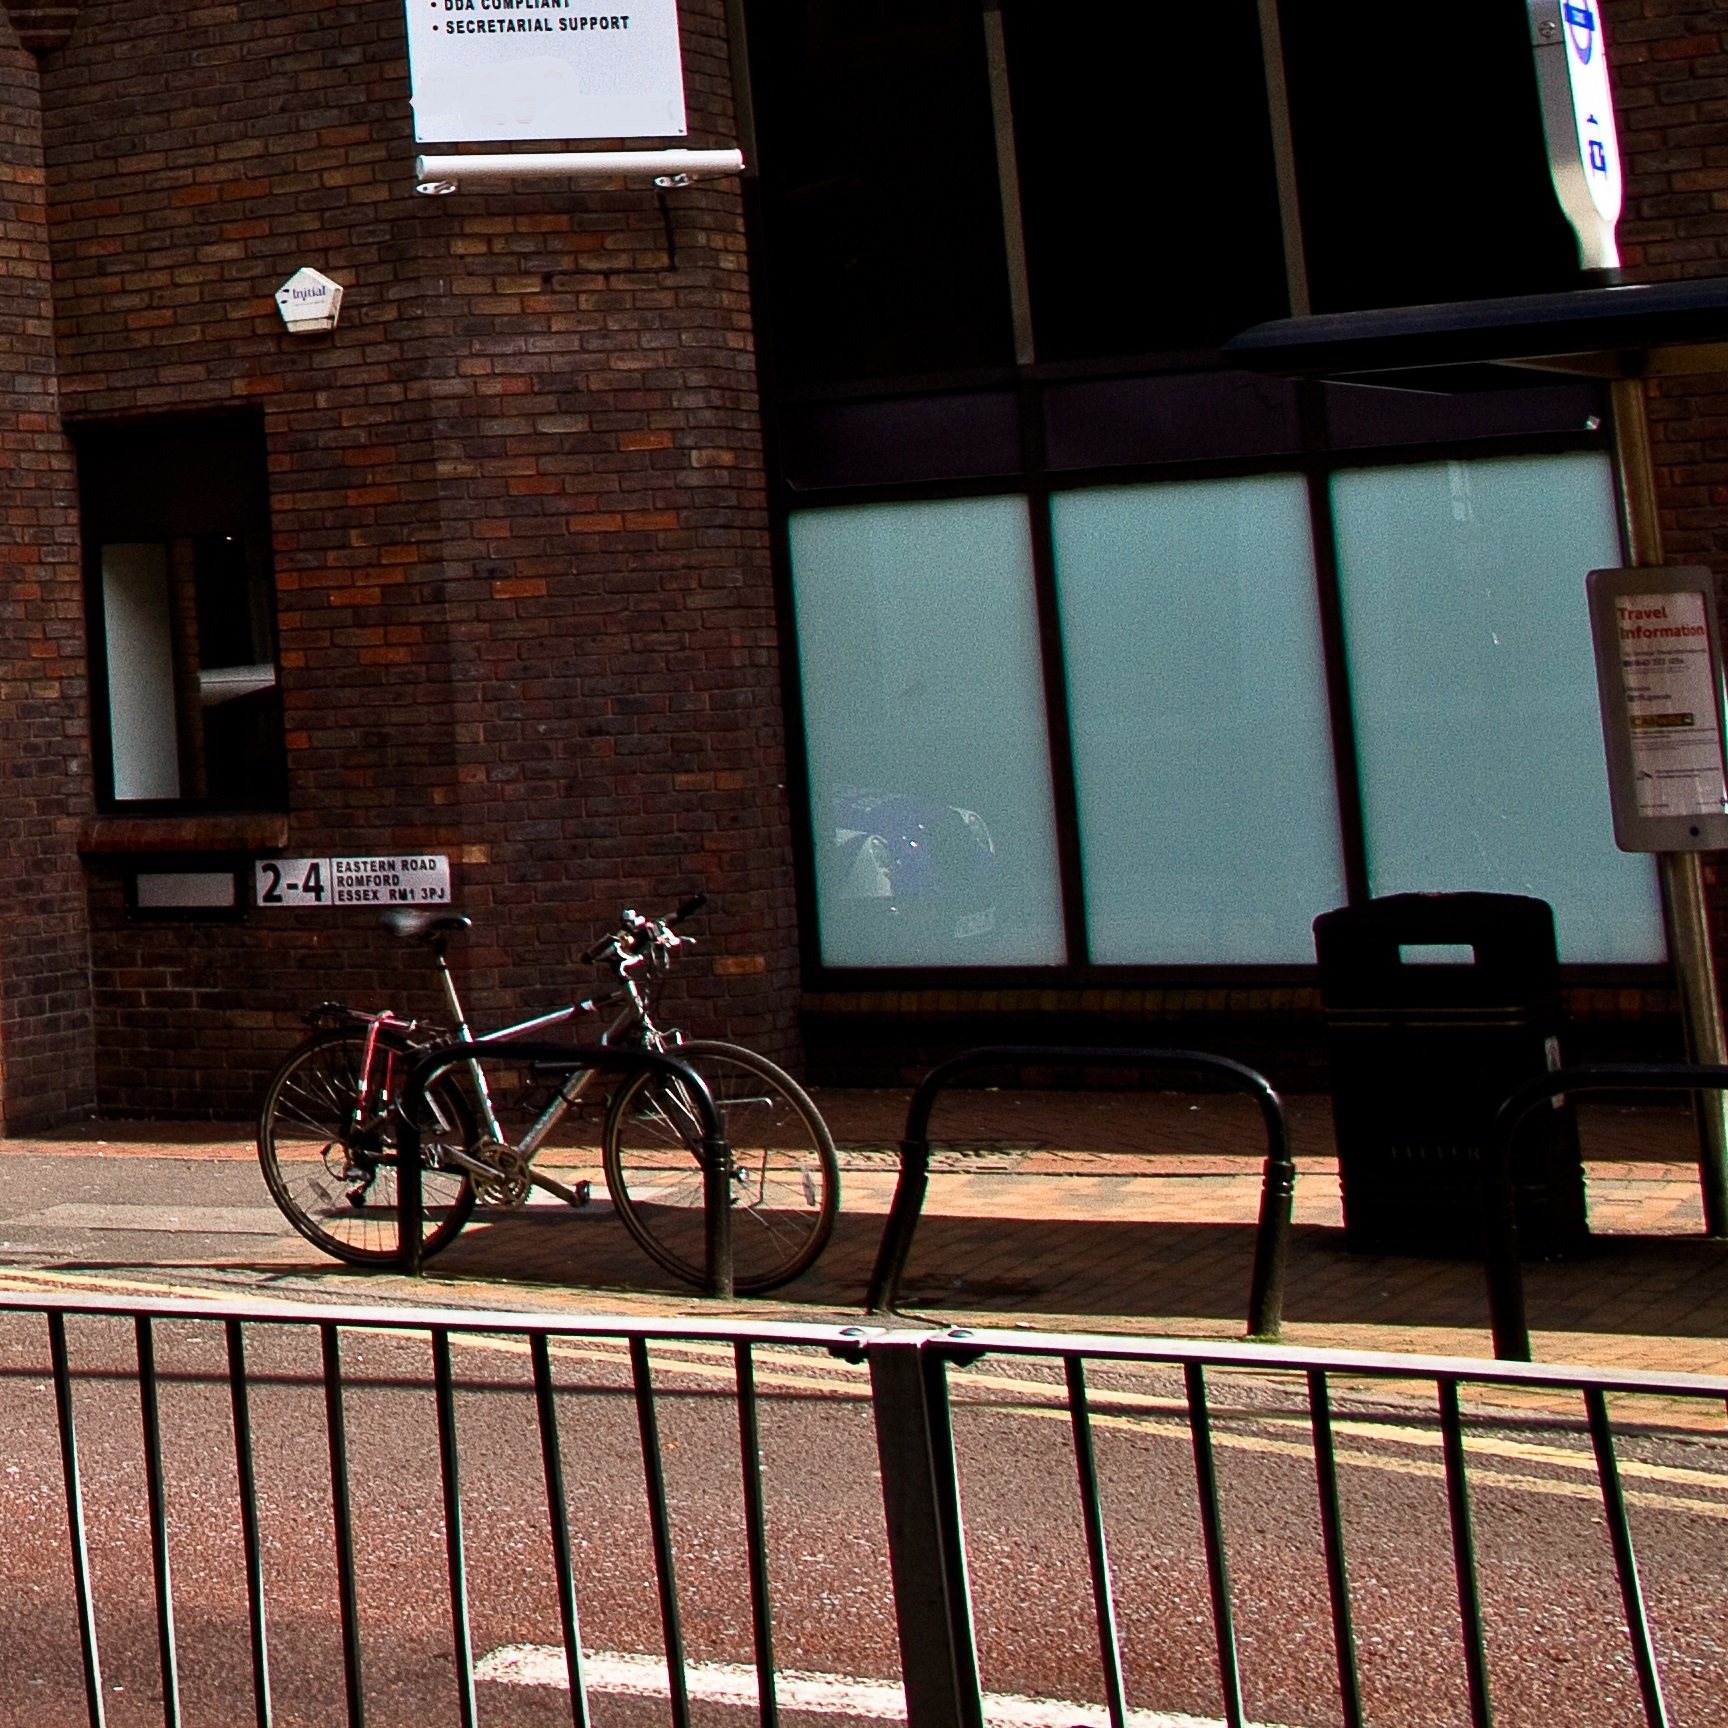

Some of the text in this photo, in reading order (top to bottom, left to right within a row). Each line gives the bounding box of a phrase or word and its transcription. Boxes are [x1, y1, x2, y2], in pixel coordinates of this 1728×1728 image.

[446, 16, 629, 34] SECRETARIAL SUPPORT
[1617, 607, 1669, 620] Travel
[1620, 624, 1705, 640] Information
[336, 859, 436, 873] EASTERN ROAD
[261, 862, 325, 903] 2-4
[336, 874, 400, 887] ROMFORD
[338, 889, 379, 901] ESSEX
[421, 887, 445, 900] 3PJ
